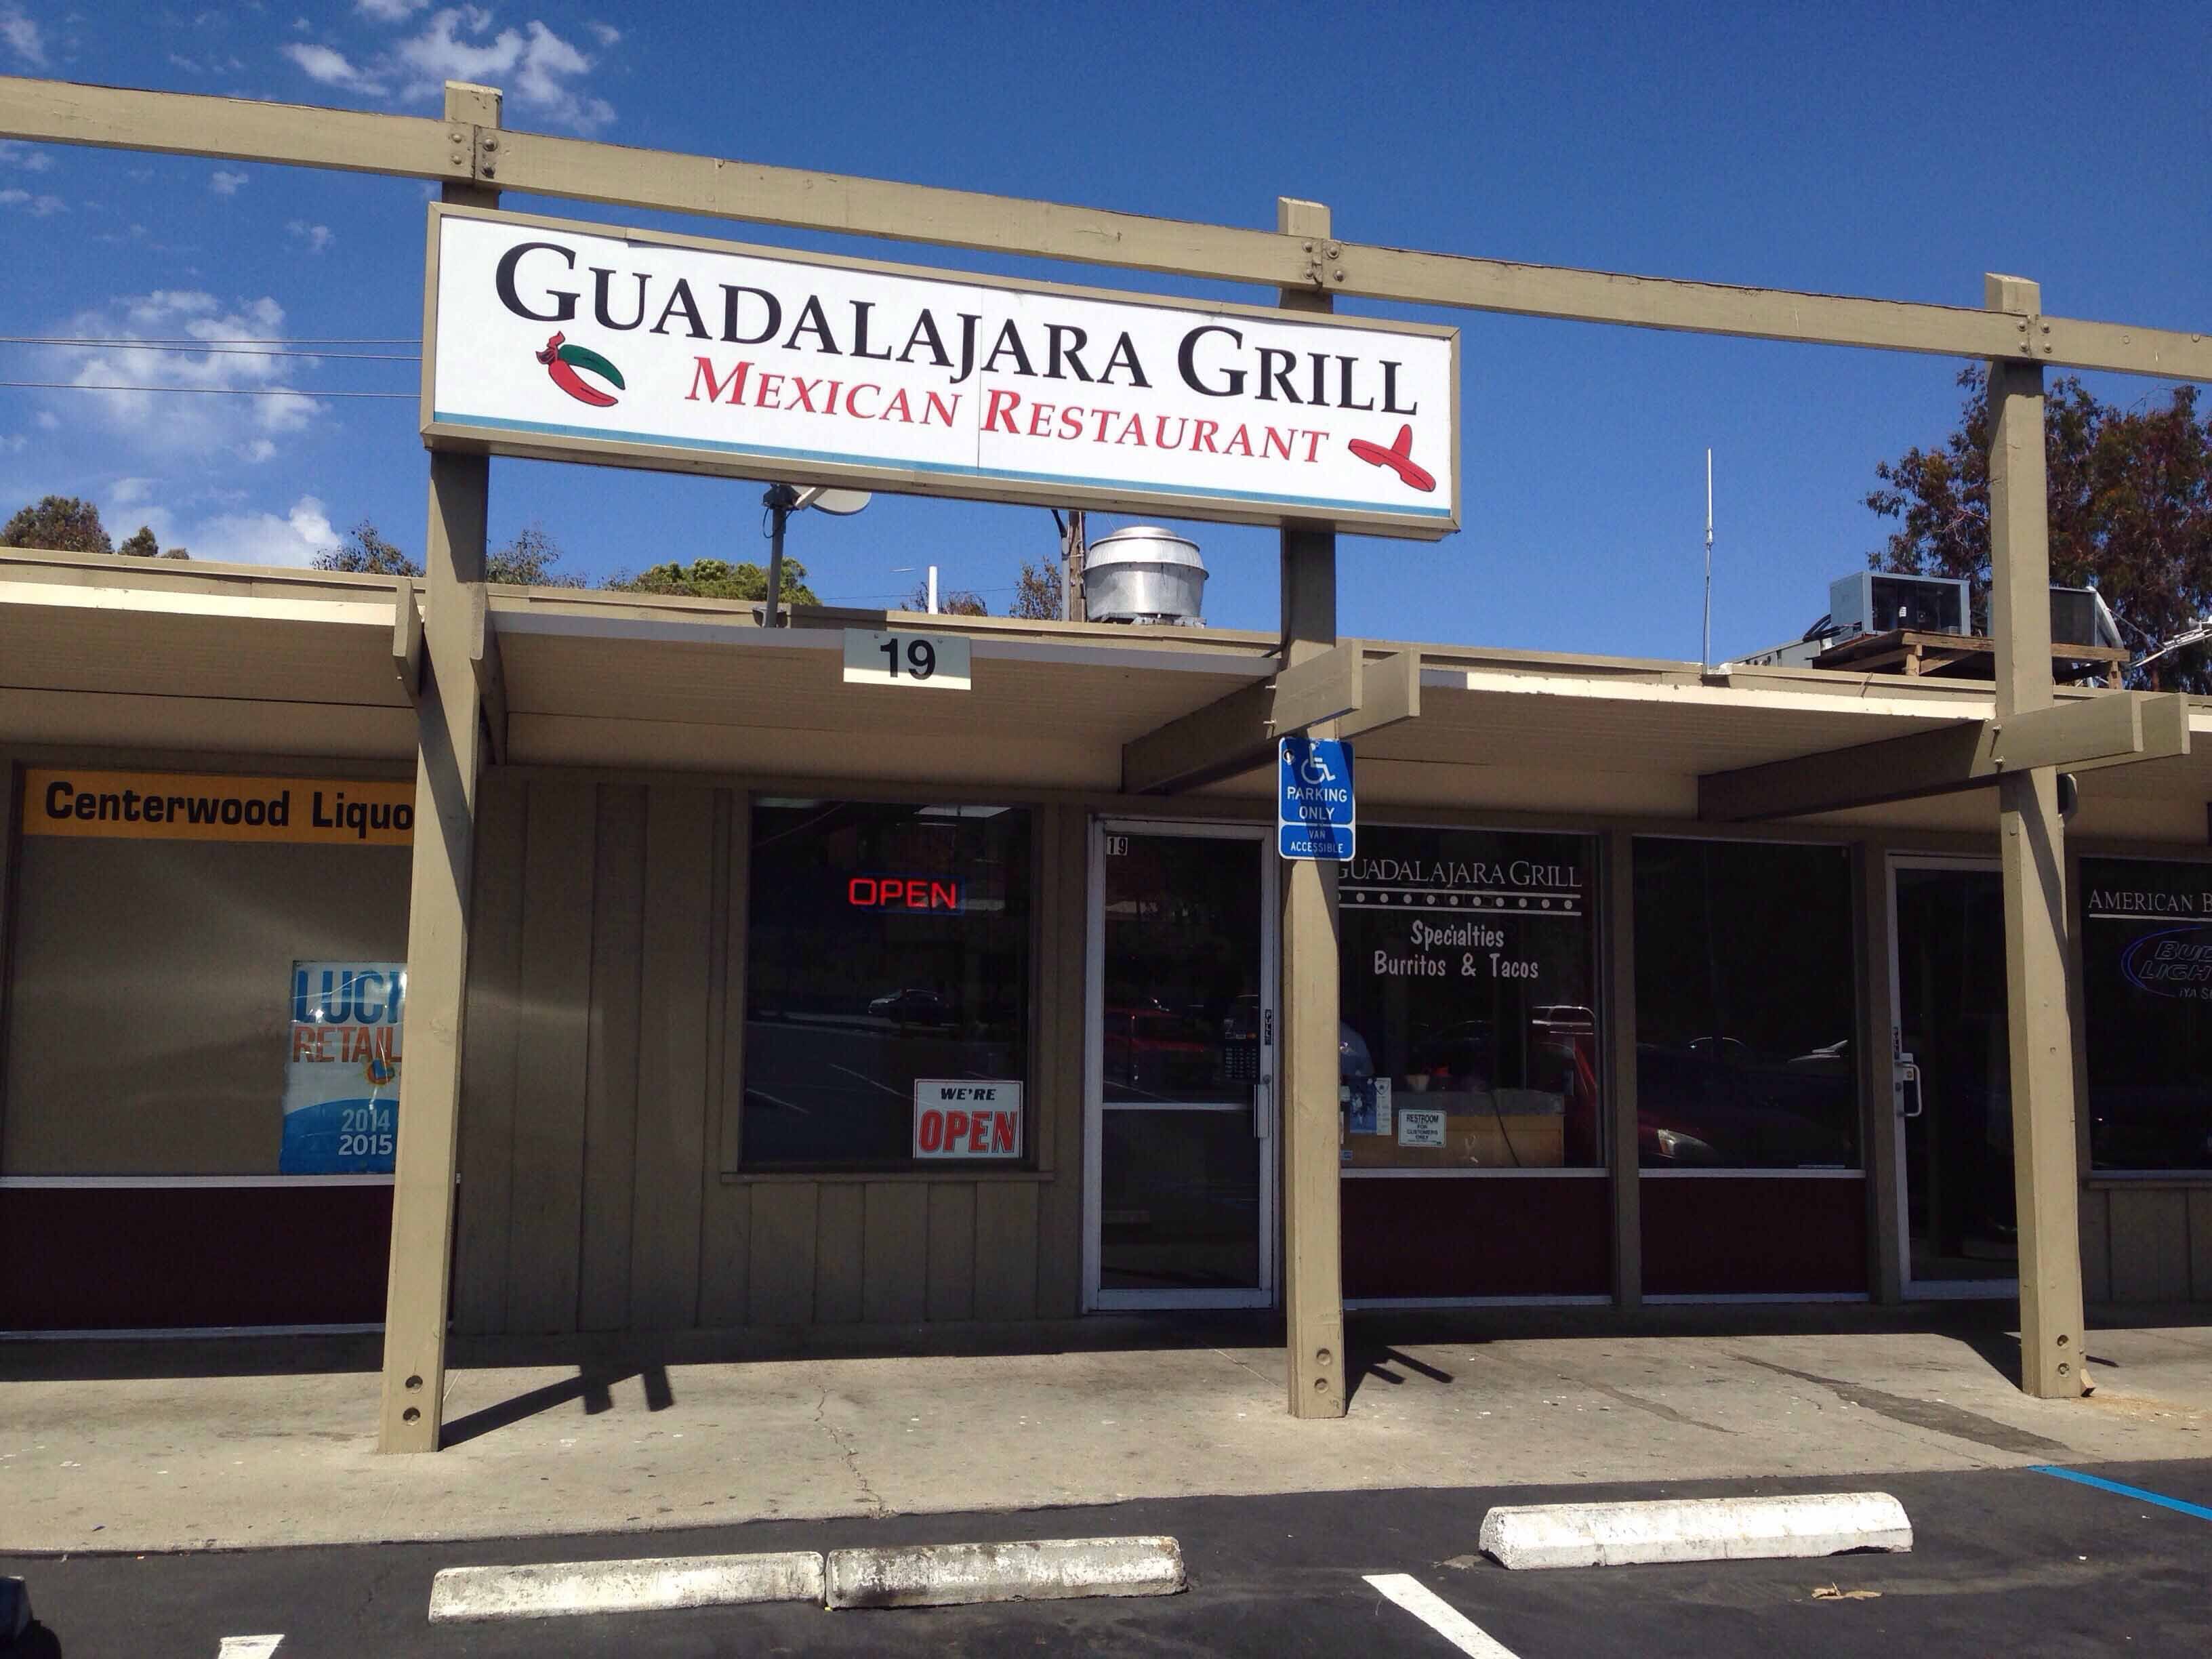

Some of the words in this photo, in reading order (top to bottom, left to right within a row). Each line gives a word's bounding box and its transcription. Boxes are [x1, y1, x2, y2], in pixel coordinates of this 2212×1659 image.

[495, 242, 1153, 388] GUADALAJARA
[1178, 325, 1418, 415] GRILL
[684, 356, 962, 428] MEXICAN
[981, 390, 1329, 463] RESTAURANT
[880, 638, 936, 680] 19
[45, 781, 289, 826] Centerwood
[1288, 787, 1347, 802] PARKING
[1299, 806, 1335, 820] ONLY
[1109, 838, 1126, 854] 19
[1309, 830, 1326, 840] VAN
[1290, 842, 1344, 853] ACCESSIBLE
[1510, 861, 1582, 887] GRILL
[848, 878, 957, 909] OPEN
[2088, 889, 2193, 912] AMERICAN
[1410, 920, 1504, 951] Specialties
[1374, 950, 1446, 976] Burritos
[1461, 954, 1476, 976] &
[1490, 953, 1538, 978] Tacos
[941, 1088, 996, 1101] WE'RE
[342, 1109, 390, 1132] 2014
[1406, 1114, 1438, 1122] RESTROOM
[918, 1109, 1018, 1153] OPEN
[338, 1134, 392, 1155] 2015
